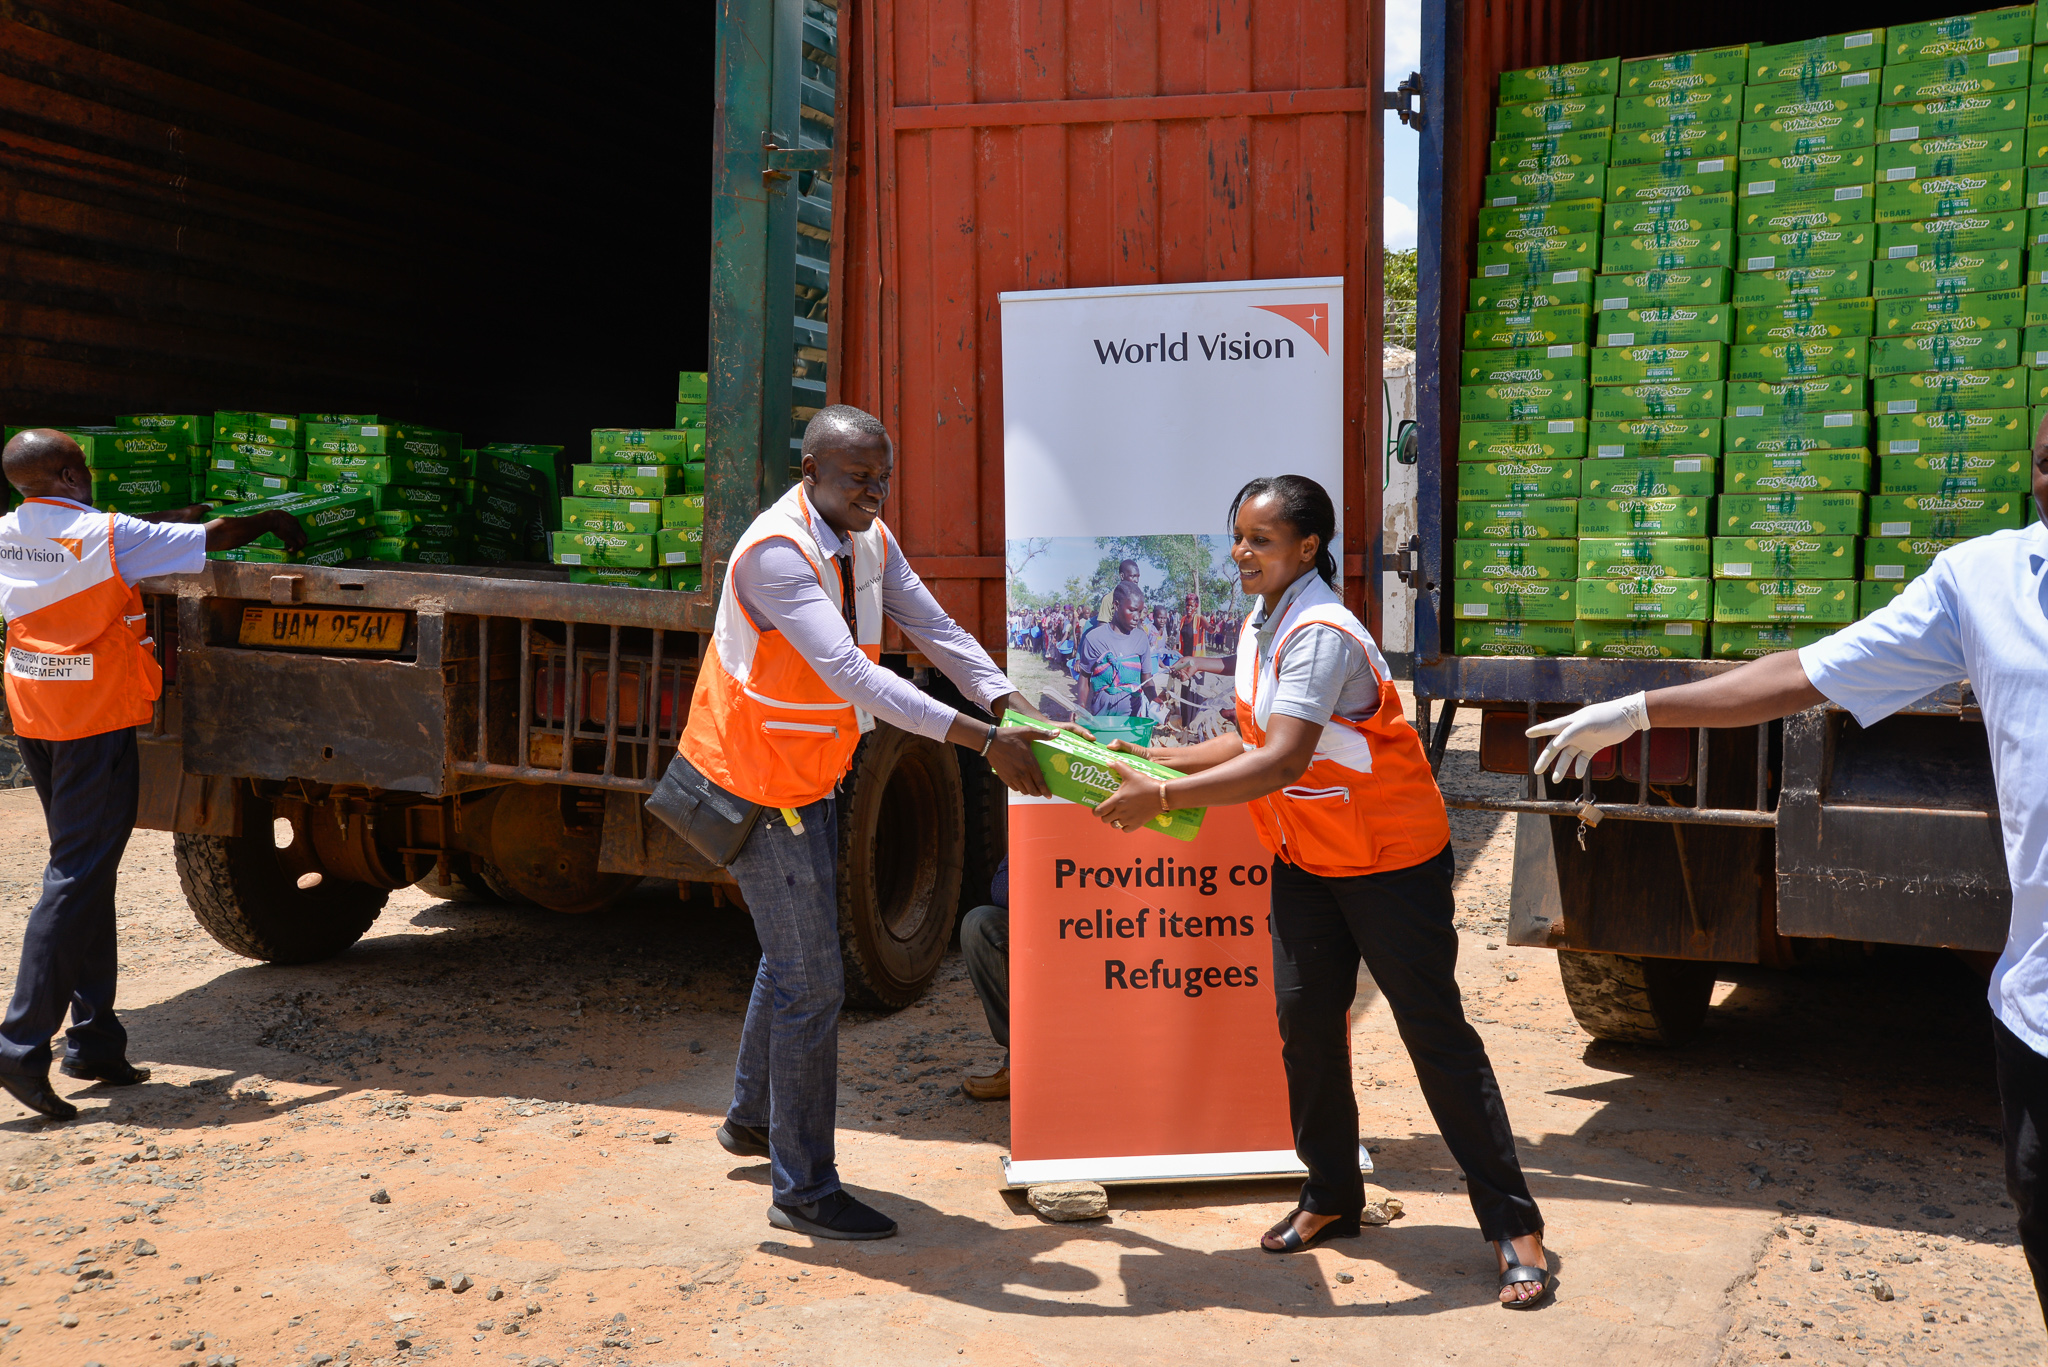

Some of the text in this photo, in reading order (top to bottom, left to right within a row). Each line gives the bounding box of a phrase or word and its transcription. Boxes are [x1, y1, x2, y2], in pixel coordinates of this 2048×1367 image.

[1920, 37, 1985, 55] White Star
[1649, 78, 1671, 89] Star
[1916, 84, 1944, 96] Star
[1962, 97, 1991, 110] Star
[1775, 105, 1801, 115] Star
[1627, 121, 1646, 130] BARS
[1783, 115, 1842, 132] White Star
[1924, 139, 1988, 155] White Star
[1817, 153, 1841, 166] Star
[1553, 172, 1574, 182] Star
[1922, 178, 1987, 195] White Star
[1636, 188, 1658, 198] Star
[1889, 208, 1912, 217] BARS
[1768, 215, 1793, 227] Star
[1925, 218, 1990, 234] White Star
[1505, 229, 1528, 239] Star
[1545, 240, 1567, 250] Star
[1672, 310, 1698, 321] Star
[1911, 320, 1940, 331] Star
[1093, 332, 1295, 364] World Vision
[1489, 369, 1542, 381] White Star
[1962, 374, 1991, 387] Star
[1635, 386, 1691, 398] White Star
[1805, 381, 1829, 393] Star
[1498, 387, 1552, 400] White Star
[140, 418, 161, 427] White
[1665, 423, 1689, 434] Star
[125, 440, 167, 452] White Star
[1488, 444, 1511, 455] Star
[614, 450, 631, 460] Star
[414, 461, 449, 474] White Star
[1498, 464, 1552, 477] White Star
[118, 479, 162, 495] White Star
[1756, 475, 1818, 488] White Star
[1884, 484, 1918, 493] 10 BARS
[425, 492, 441, 502] Star
[1653, 501, 1676, 512] Star
[1918, 498, 1985, 511] White Star
[316, 508, 356, 527] White Star
[1751, 520, 1812, 533] White Star
[584, 536, 627, 546] White Star
[1794, 540, 1820, 552] Star
[0, 546, 64, 562] orld Vision
[323, 548, 344, 561] White
[619, 568, 641, 576] Star
[1483, 564, 1538, 577] White Star
[1607, 564, 1664, 577] White Star
[856, 580, 870, 592] World
[1494, 583, 1549, 595] White Star
[1653, 584, 1677, 595] Star
[1797, 584, 1822, 595] Star
[1589, 607, 1609, 615] BARS
[1727, 607, 1749, 615] BARS
[273, 613, 391, 643] UAM 954V
[1481, 643, 1504, 653] Star
[1603, 644, 1659, 657] White Star
[41, 656, 91, 665] CENTRE
[14, 663, 72, 676] MANAGEMENT
[1070, 761, 1120, 793] White
[1055, 858, 1267, 896] Providing co
[1059, 909, 1150, 940] relief
[1159, 911, 1254, 938] items
[1104, 959, 1258, 998] Refugees
